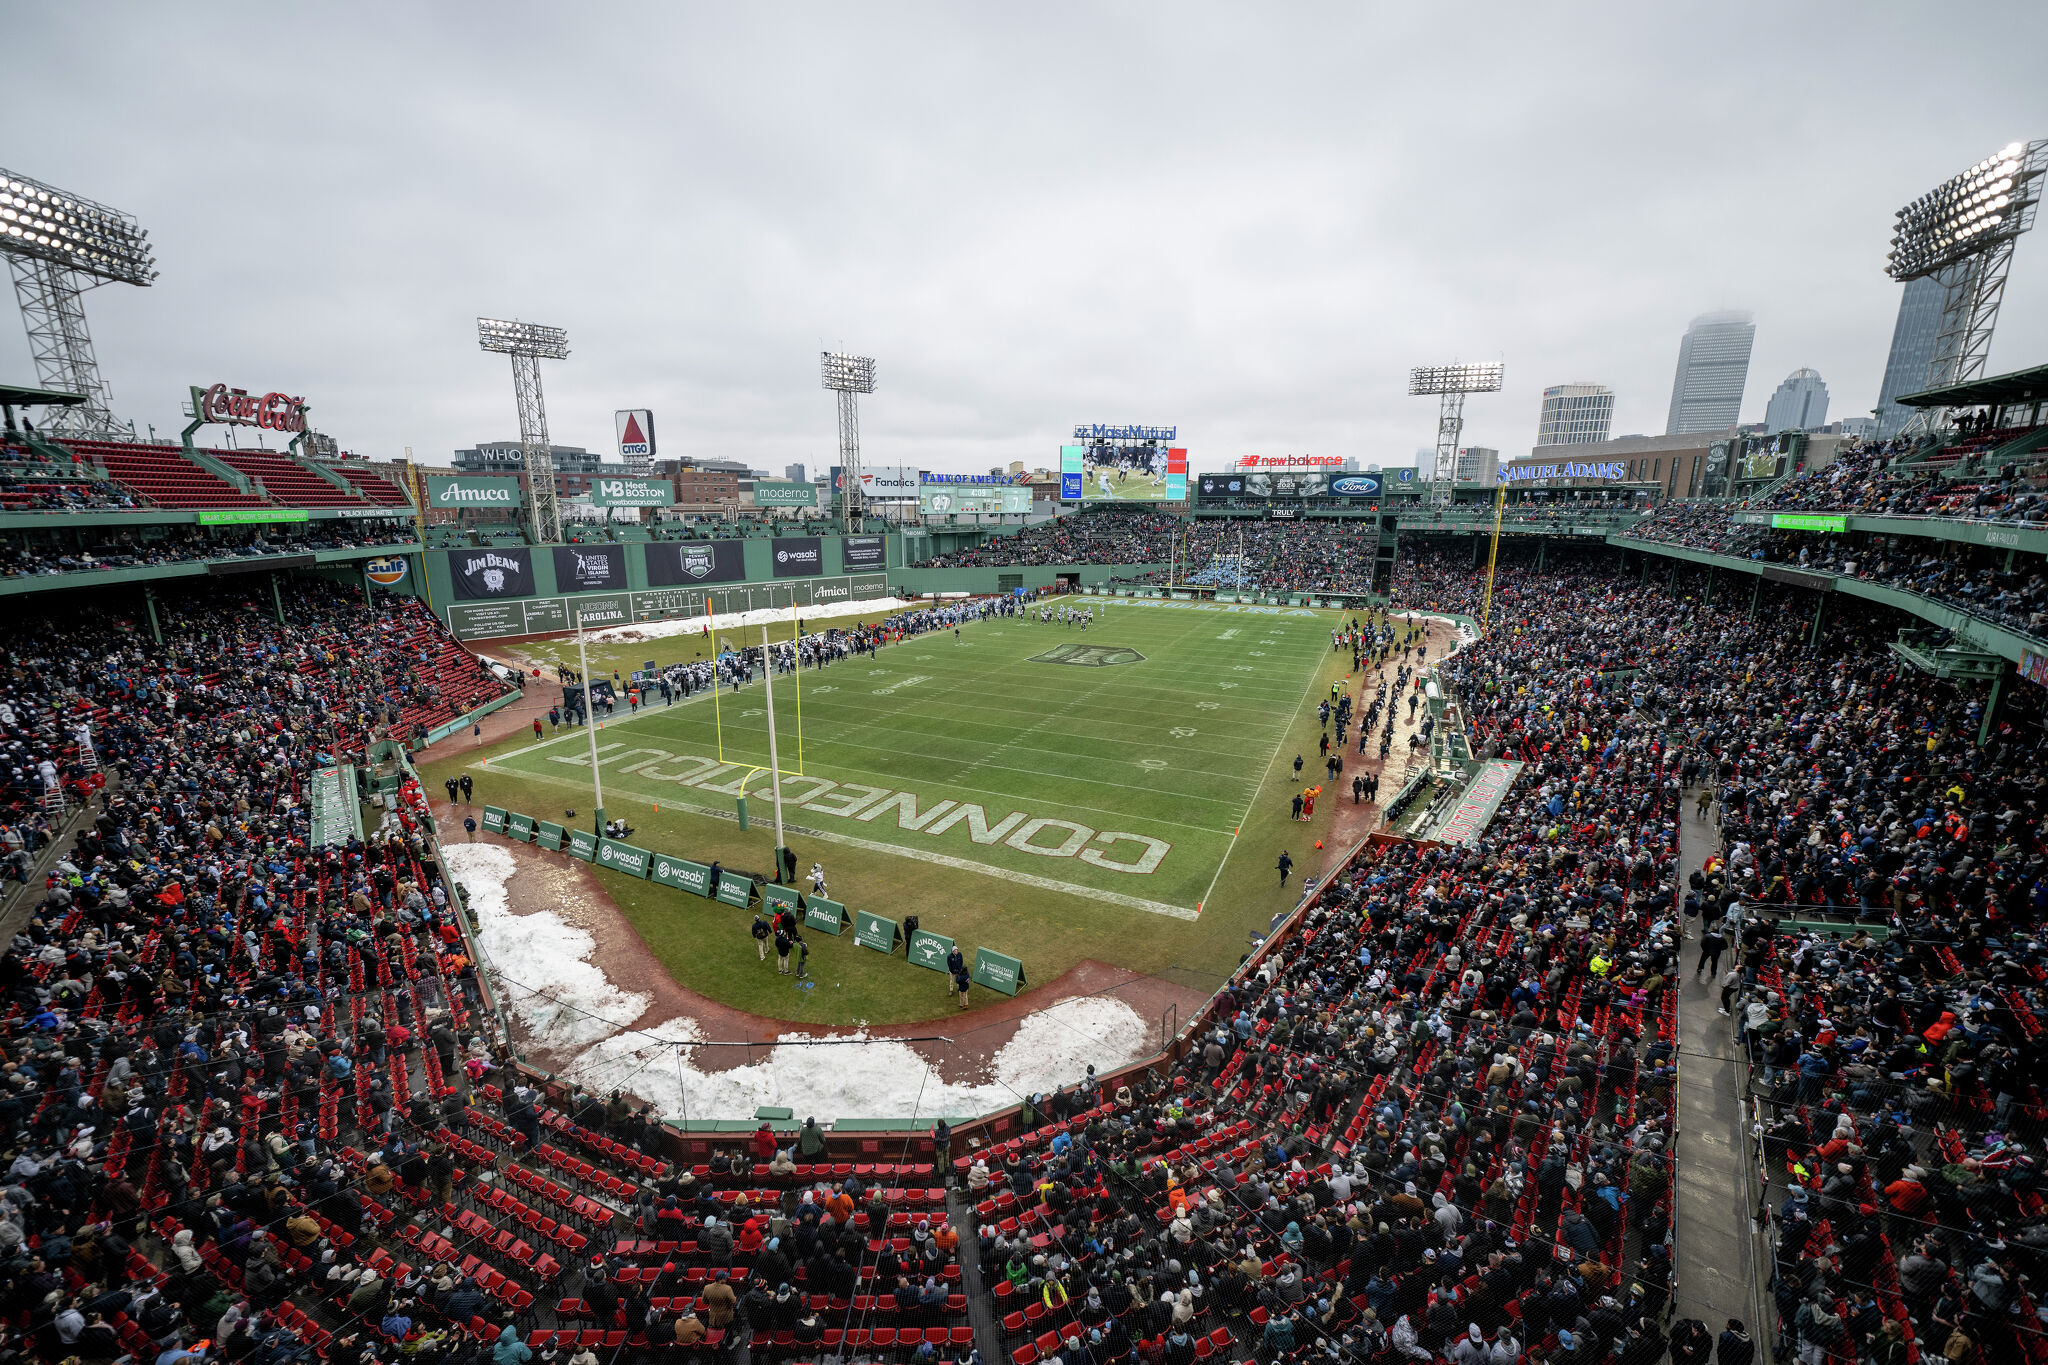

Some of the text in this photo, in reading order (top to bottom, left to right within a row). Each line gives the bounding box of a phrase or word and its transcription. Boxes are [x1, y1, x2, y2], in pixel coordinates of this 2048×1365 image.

[203, 383, 306, 432] Coca-Cola
[1092, 423, 1176, 440] MassMutual
[622, 444, 647, 454] CITGO
[922, 473, 1013, 484] BANK OF AMERICA
[1496, 461, 1625, 483] SAMUEL ADAMS
[625, 481, 647, 489] Meet
[875, 477, 915, 487] Fanaics
[1341, 481, 1368, 491] Ford
[440, 483, 510, 501] Amica
[625, 489, 665, 497] BOSTON
[759, 487, 809, 498] moderna
[932, 489, 1019, 511] 27 4:09 7
[788, 549, 817, 559] wasabi
[366, 560, 404, 573] Gulf
[464, 553, 520, 577] JIM BEAM
[814, 585, 848, 598] Amica
[853, 583, 884, 591] moderna
[580, 600, 618, 612] UCONN
[1074, 598, 1318, 617] CAROLINA
[545, 743, 1172, 874] CONNECTICUT
[1440, 769, 1510, 842] BOSTON RED SOX
[485, 811, 503, 824] TRULY
[510, 820, 529, 834] Amica
[540, 830, 560, 841] moderna
[612, 849, 644, 866] wasabi
[671, 866, 705, 884] wasabi
[808, 906, 838, 924] Amica
[858, 932, 887, 946] FOUNDATION
[915, 938, 946, 955] KINDER'S
